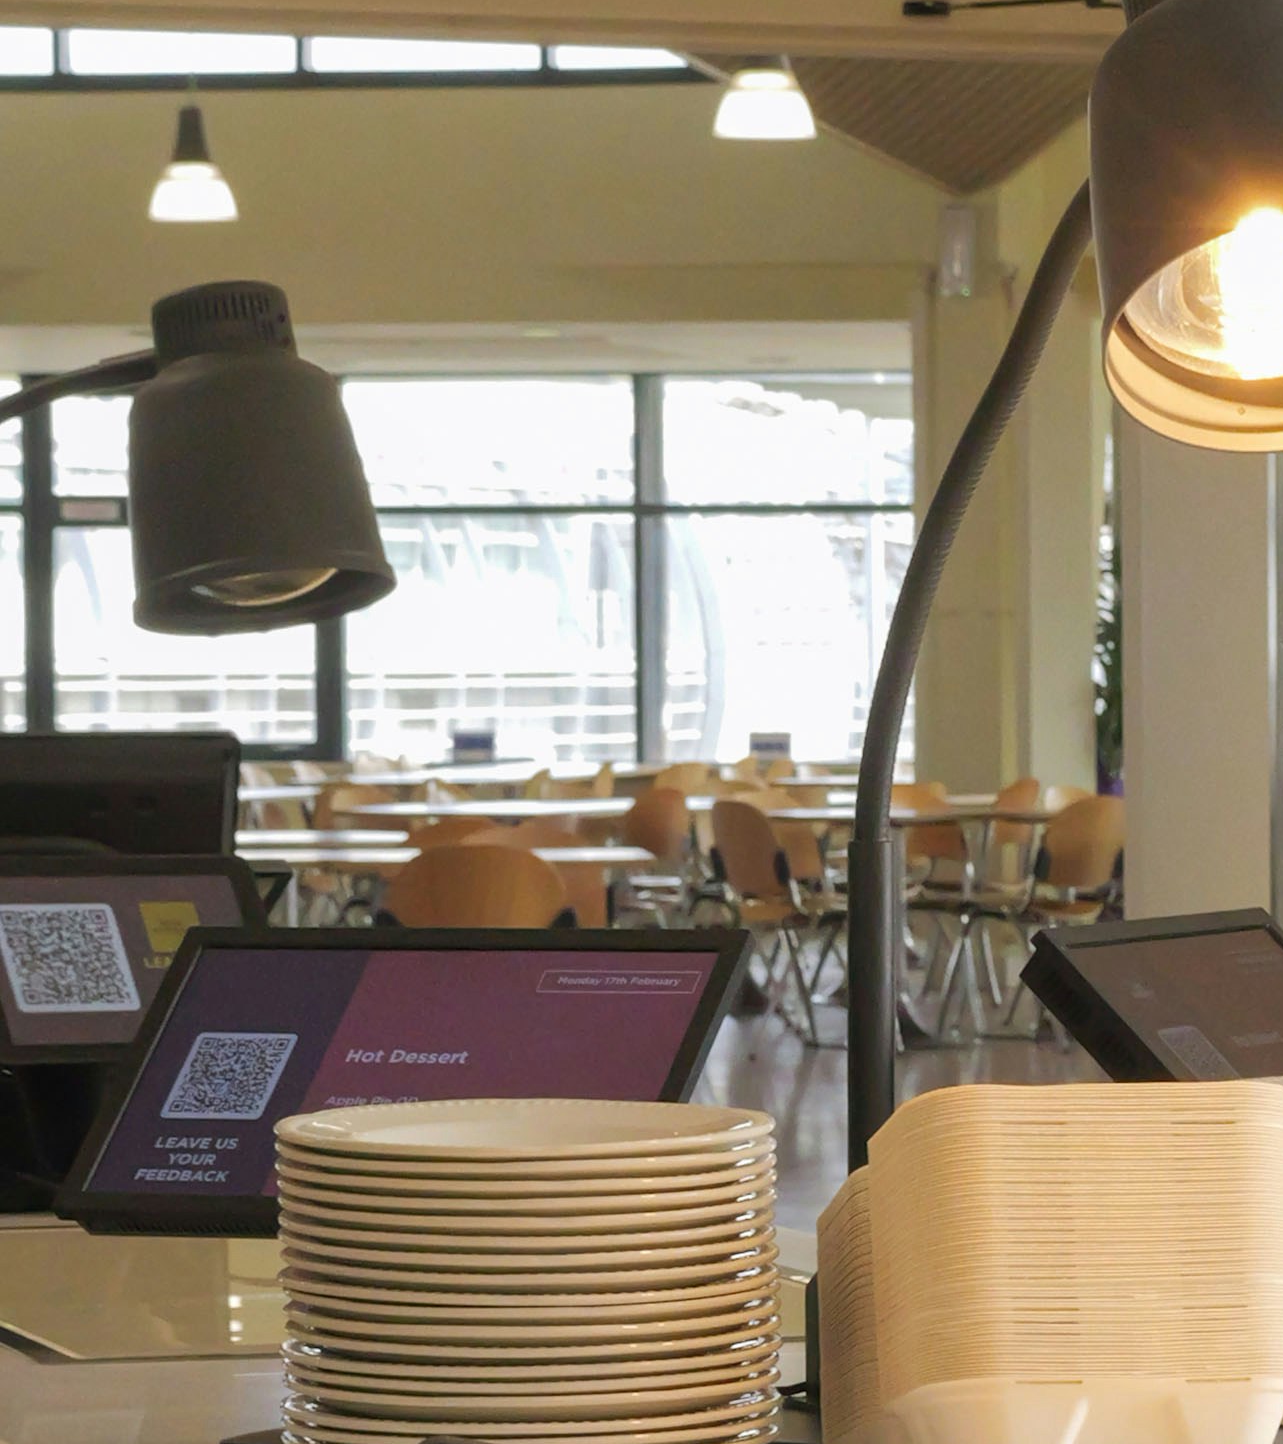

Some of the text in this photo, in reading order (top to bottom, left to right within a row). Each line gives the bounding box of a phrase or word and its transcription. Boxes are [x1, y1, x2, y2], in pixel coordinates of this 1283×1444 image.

[557, 976, 681, 987] Monday 17th February
[345, 1049, 469, 1064] Hot Dessert
[324, 1095, 367, 1106] Apple
[154, 1137, 239, 1149] LEAVE US
[168, 1153, 217, 1165] YOUR
[134, 1168, 230, 1182] FEEDBACK
